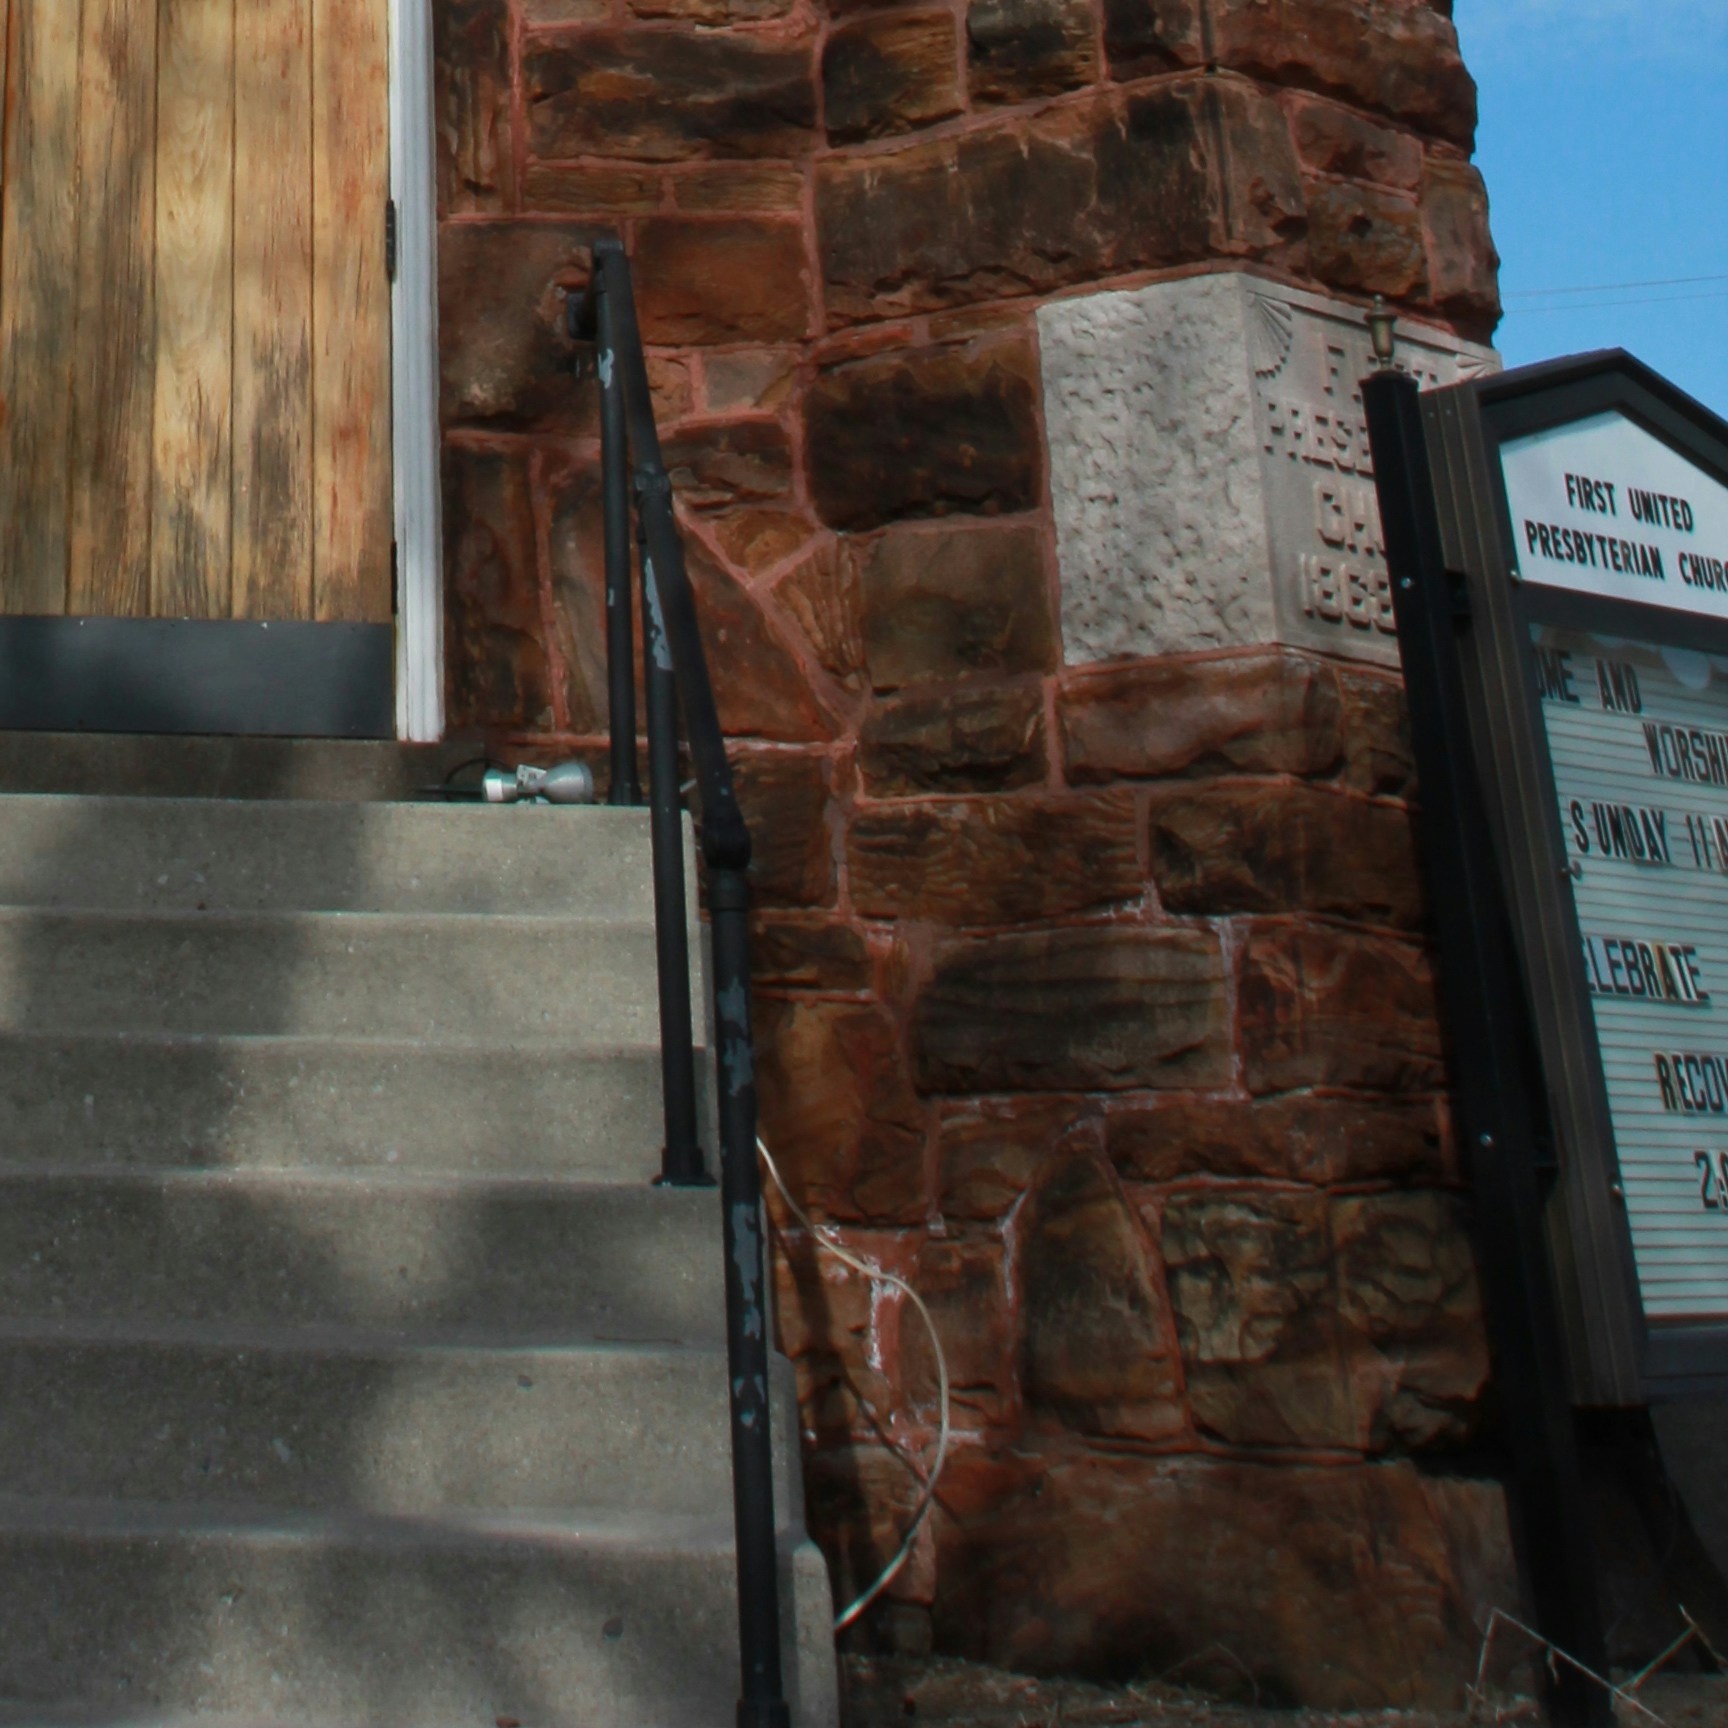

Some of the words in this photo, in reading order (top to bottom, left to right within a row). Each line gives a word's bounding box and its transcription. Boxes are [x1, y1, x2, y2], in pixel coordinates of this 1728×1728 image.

[1564, 472, 1616, 516] FIRST
[1627, 487, 1694, 532] UNITED
[1524, 519, 1665, 580] PRESBYTERIAN
[1595, 658, 1643, 714] AND
[1642, 722, 1728, 787] WORSHI
[1570, 800, 1670, 863] SUNDAY
